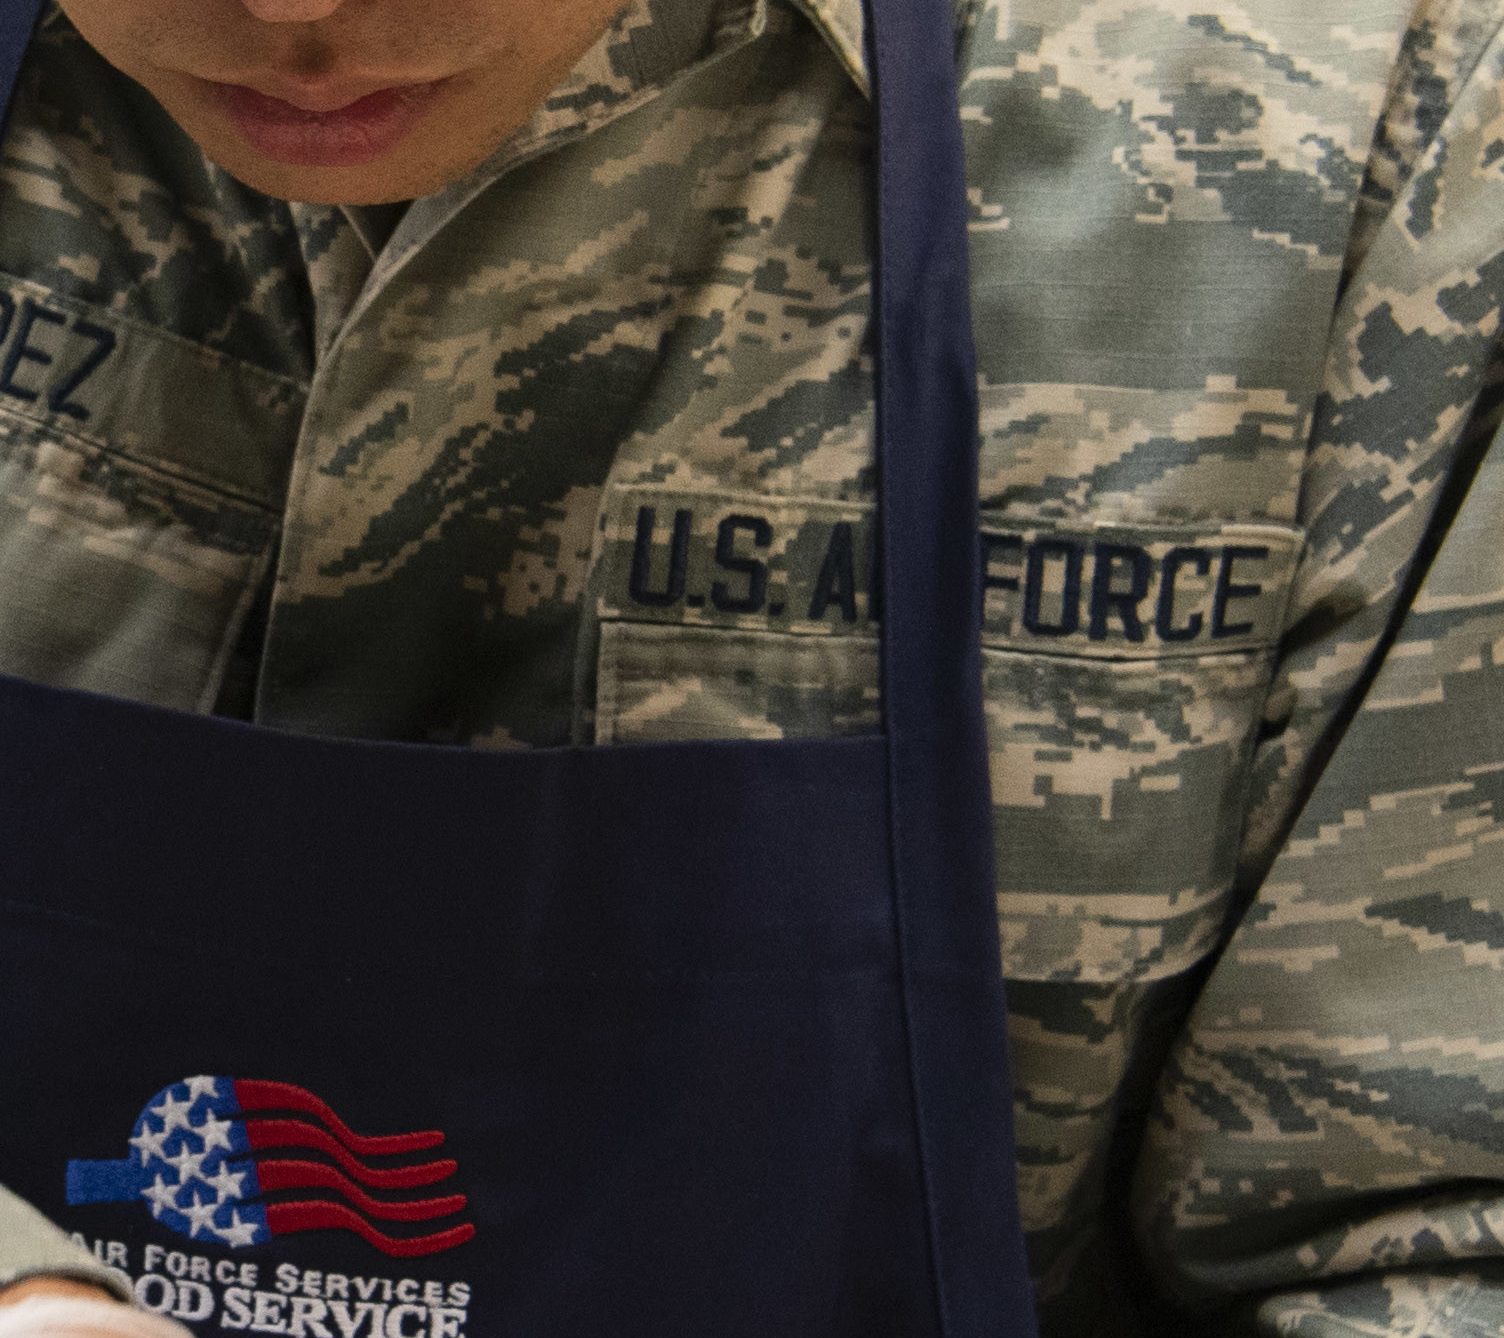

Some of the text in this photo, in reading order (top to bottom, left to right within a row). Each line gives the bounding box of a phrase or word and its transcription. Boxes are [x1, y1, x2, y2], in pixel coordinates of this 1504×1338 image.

[628, 506, 785, 617] U.S.
[980, 531, 1269, 643] FORCE
[145, 1244, 259, 1287] FORCE
[275, 1263, 471, 1307] SERVICES
